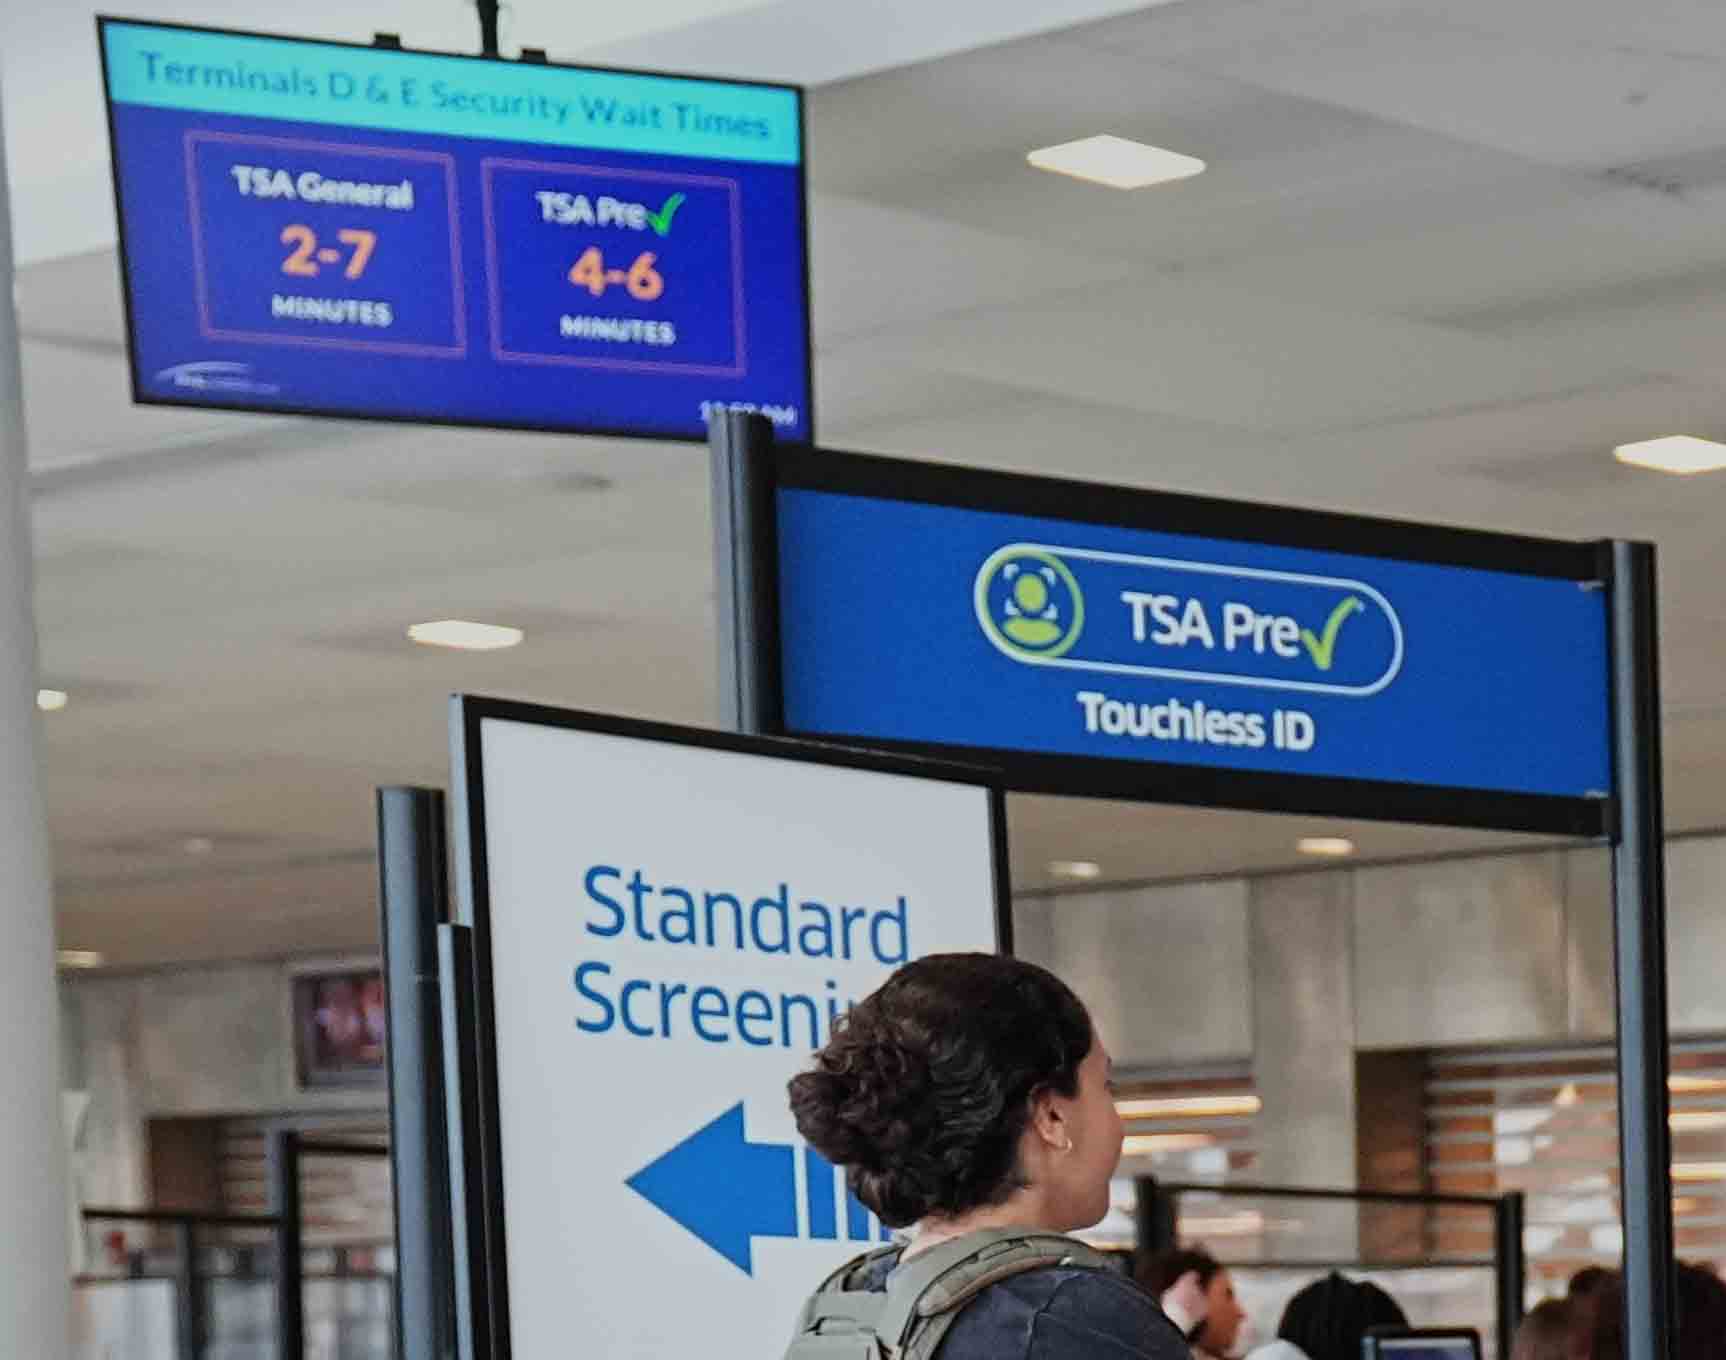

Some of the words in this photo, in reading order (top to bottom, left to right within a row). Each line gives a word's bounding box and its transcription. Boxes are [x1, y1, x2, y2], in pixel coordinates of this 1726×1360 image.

[140, 50, 318, 97] Terminals
[328, 71, 357, 100] D
[365, 73, 391, 104] &
[401, 77, 419, 107] E
[431, 79, 568, 126] Security
[578, 93, 663, 130] Wait
[672, 101, 771, 140] Times
[230, 164, 296, 199] TSA
[296, 171, 415, 212] General
[534, 190, 596, 227] TSA
[596, 195, 648, 231] Pre
[280, 223, 377, 280] 2-7
[568, 245, 665, 301] 4-6
[271, 293, 394, 328] MINUTES
[560, 313, 676, 348] MINUTES
[1121, 590, 1214, 649] TSA
[1224, 602, 1300, 658] Pre
[1076, 691, 1265, 747] Touchless
[1274, 709, 1316, 752] ID
[583, 864, 911, 965] Standard
[573, 961, 855, 1049] Screeni
